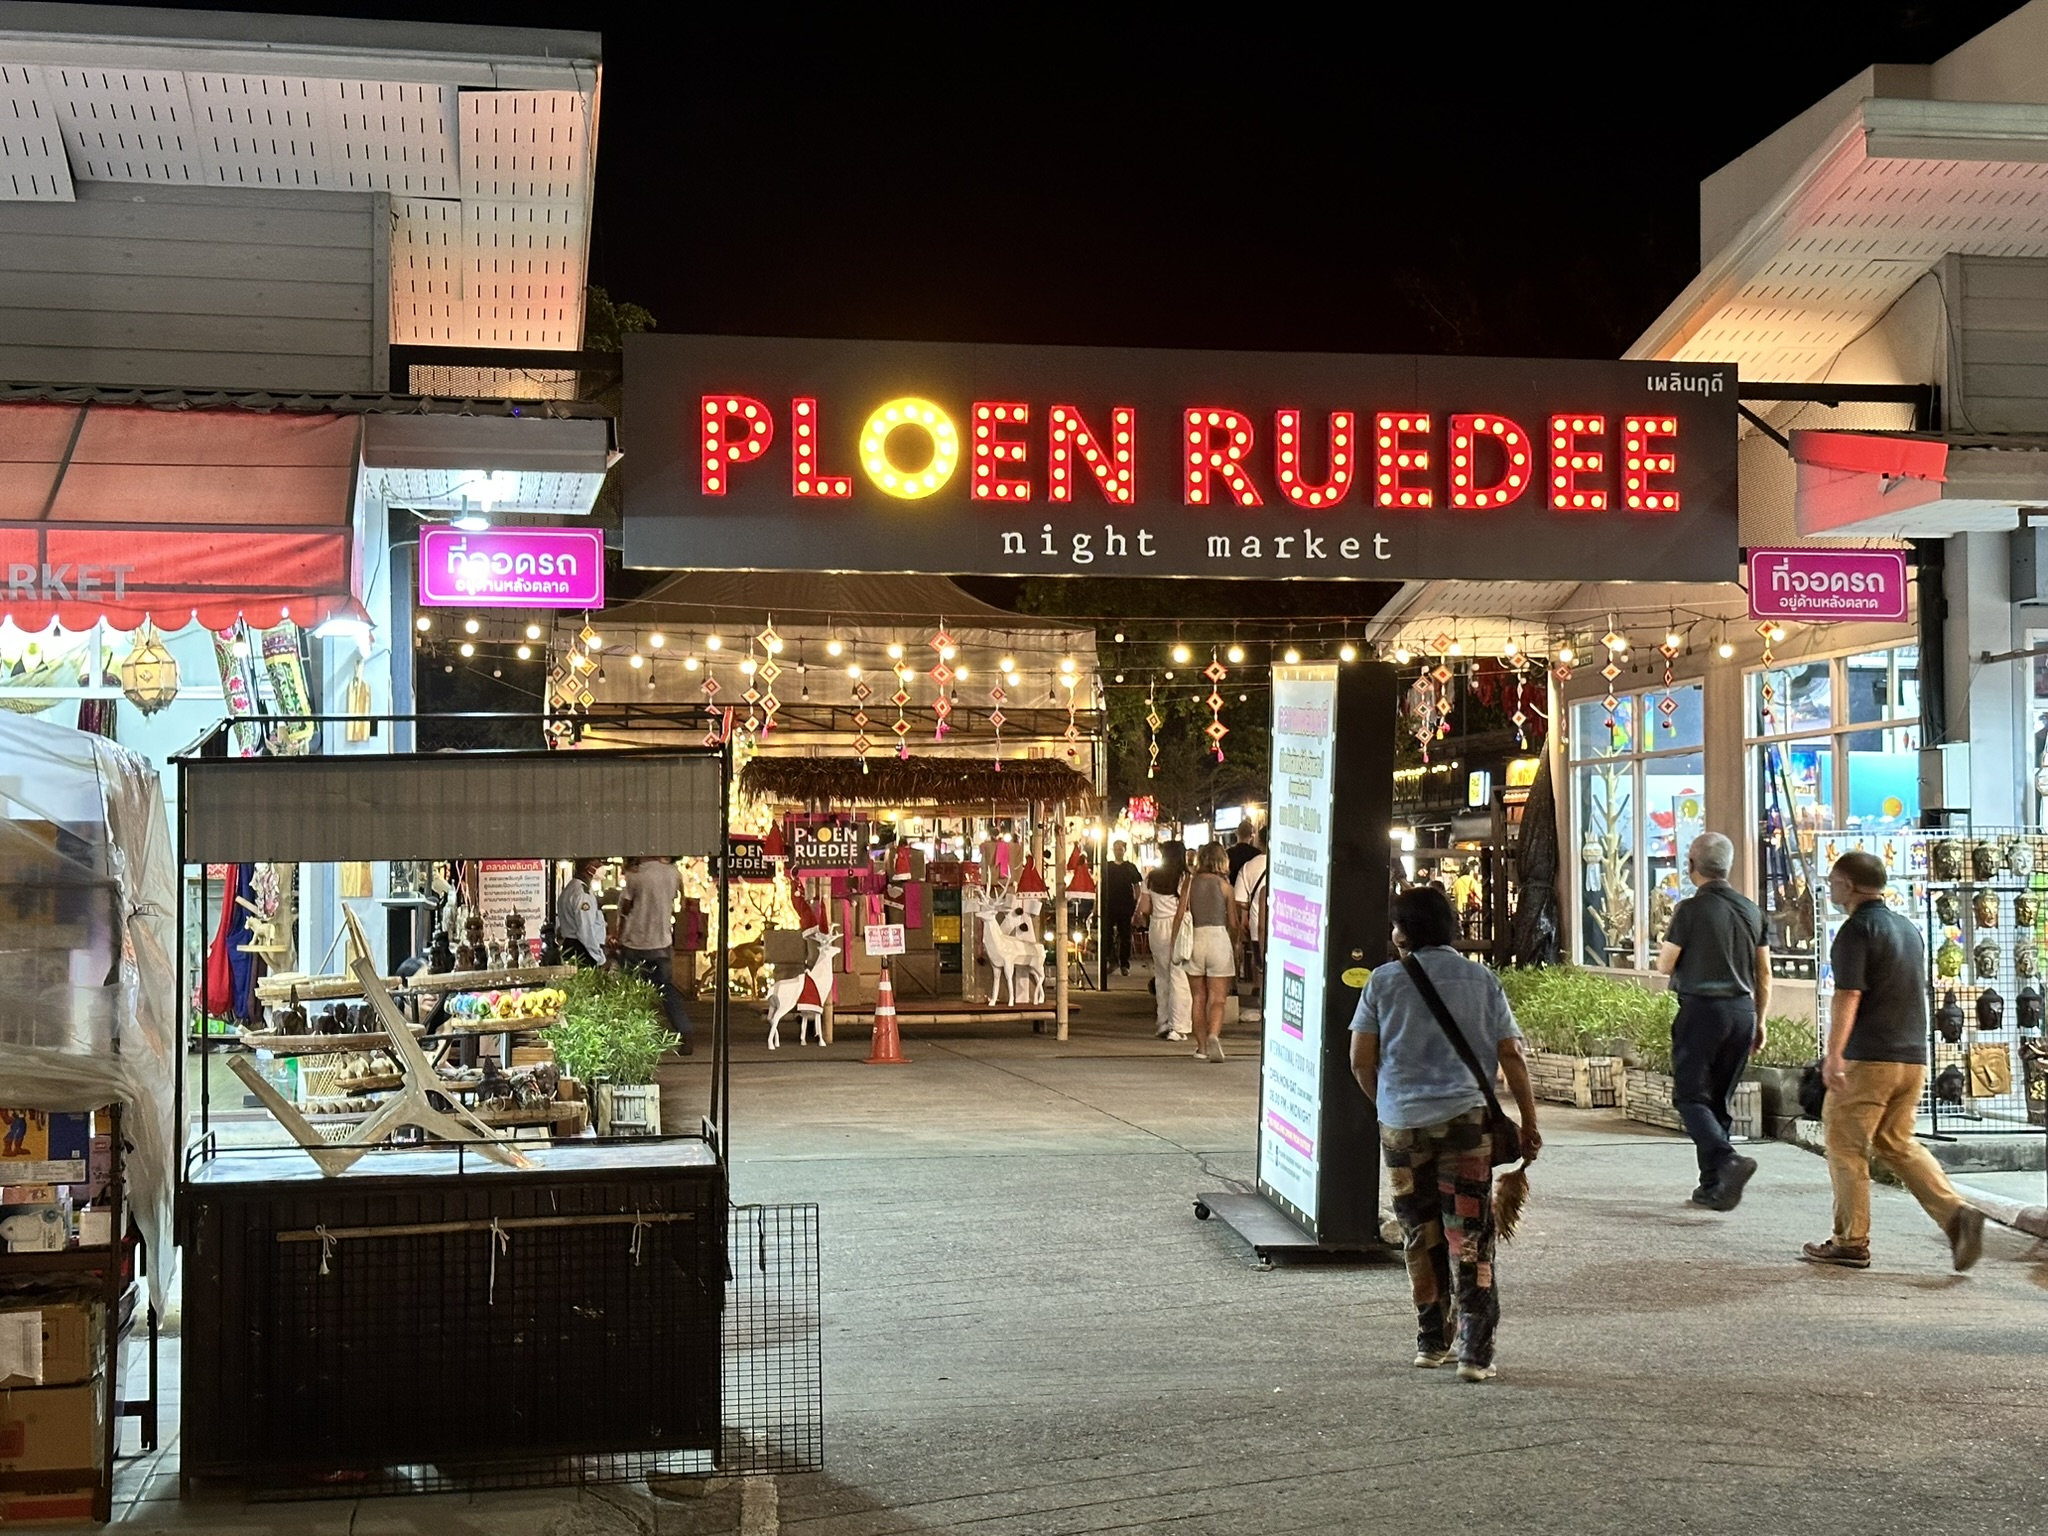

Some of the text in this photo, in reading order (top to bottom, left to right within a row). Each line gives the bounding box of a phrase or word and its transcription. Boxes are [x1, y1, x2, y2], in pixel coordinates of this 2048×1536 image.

[1647, 372, 1723, 397] เพลินฤดี
[702, 395, 1680, 512] PLOEN RUEDEE
[1001, 523, 1392, 564] night market
[0, 563, 135, 601] RKET
[1772, 557, 1885, 593] ที่จอดรถ
[1779, 594, 1878, 611] อยู่ด้านหลังตลาด
[728, 844, 764, 857] LOEN
[795, 844, 858, 857] RUEDEE
